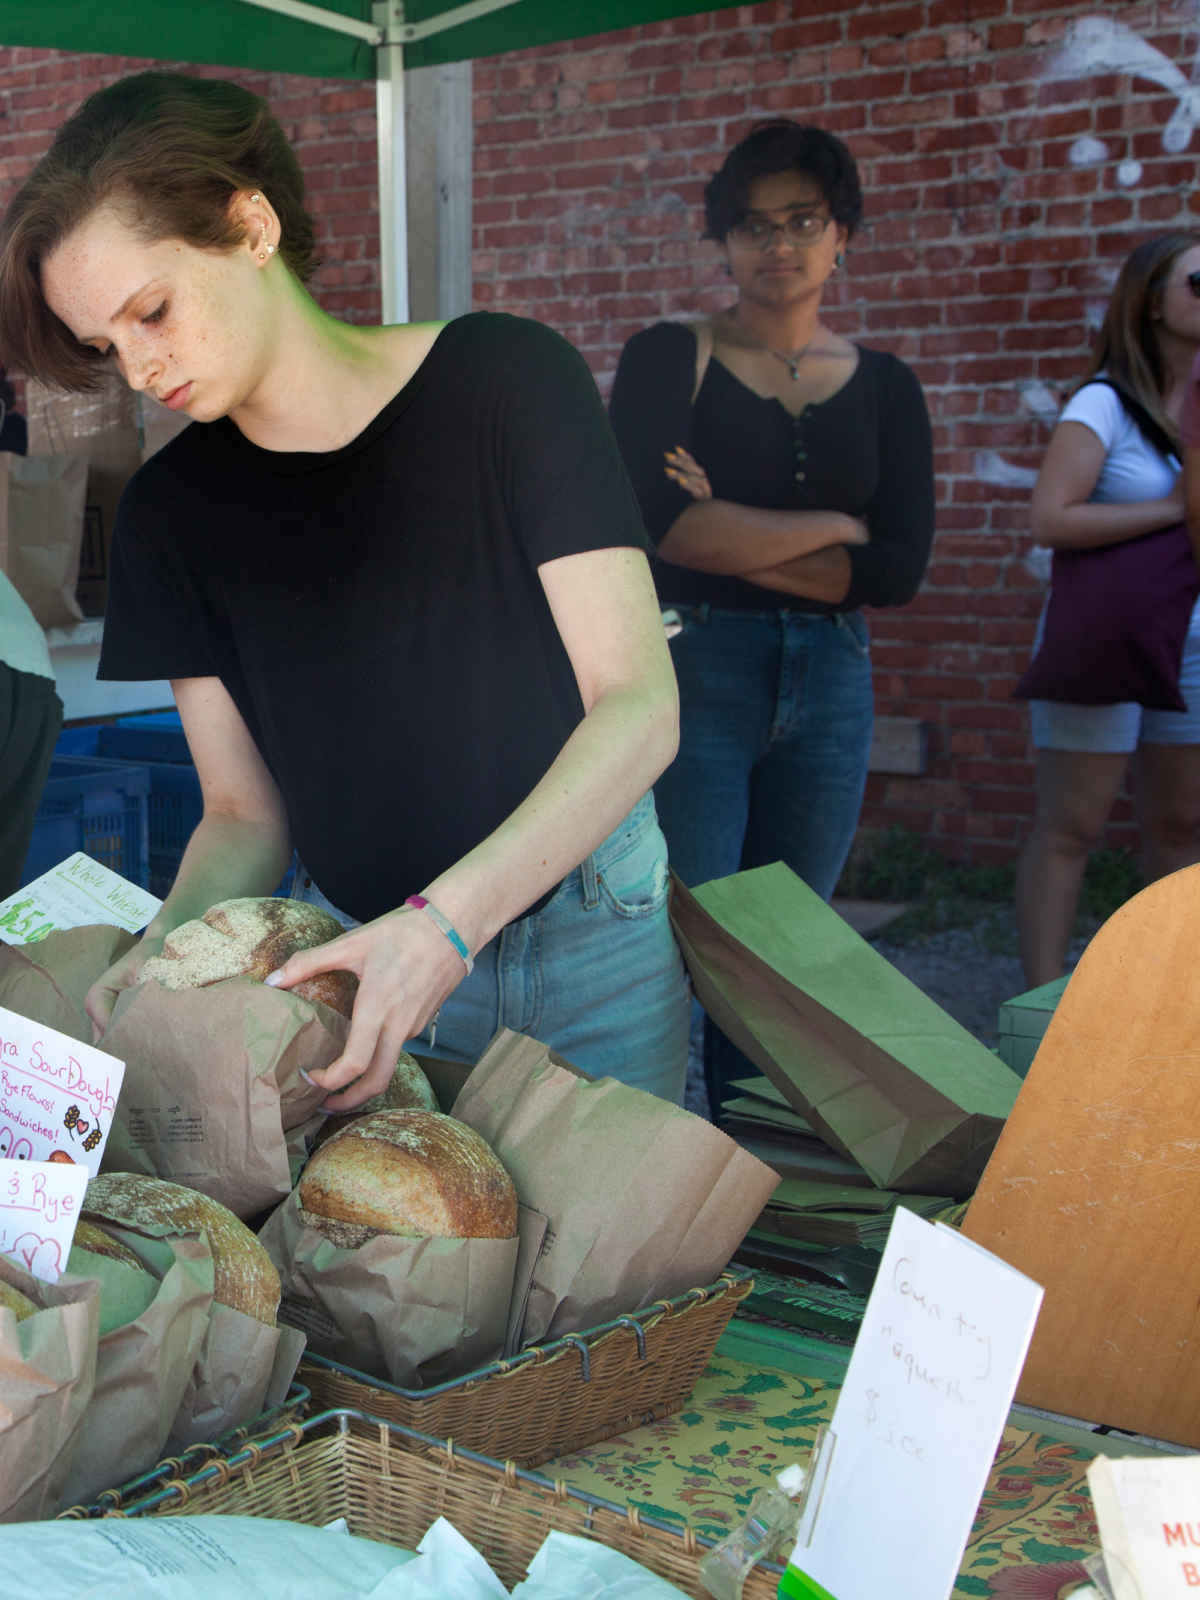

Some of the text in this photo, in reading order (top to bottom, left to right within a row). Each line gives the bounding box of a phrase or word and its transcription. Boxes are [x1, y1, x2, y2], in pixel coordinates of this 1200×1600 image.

[30, 1040, 115, 1118] SourDough
[0, 1098, 60, 1144] Sandwiches!
[31, 1171, 75, 1224] Rye
